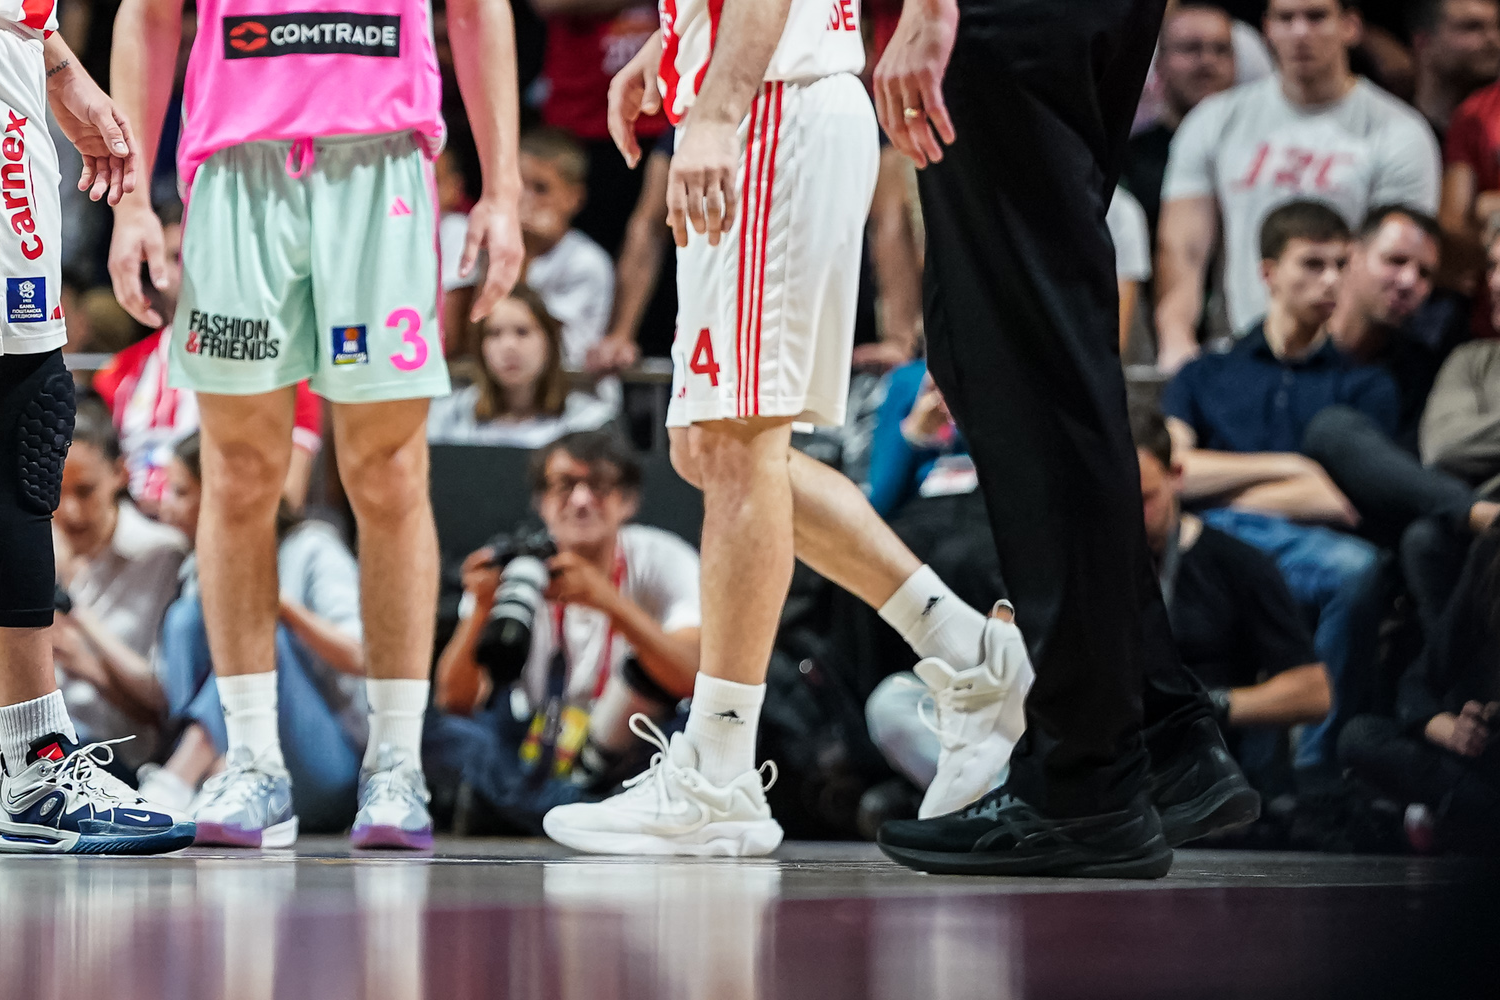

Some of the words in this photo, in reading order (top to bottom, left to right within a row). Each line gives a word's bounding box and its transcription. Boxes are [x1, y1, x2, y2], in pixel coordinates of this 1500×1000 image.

[270, 22, 397, 46] COMTRADE
[0, 108, 44, 261] carnex
[186, 333, 279, 361] &FRIENDS
[189, 309, 269, 341] FASHION
[385, 306, 429, 371] 3
[690, 327, 720, 387] 4
